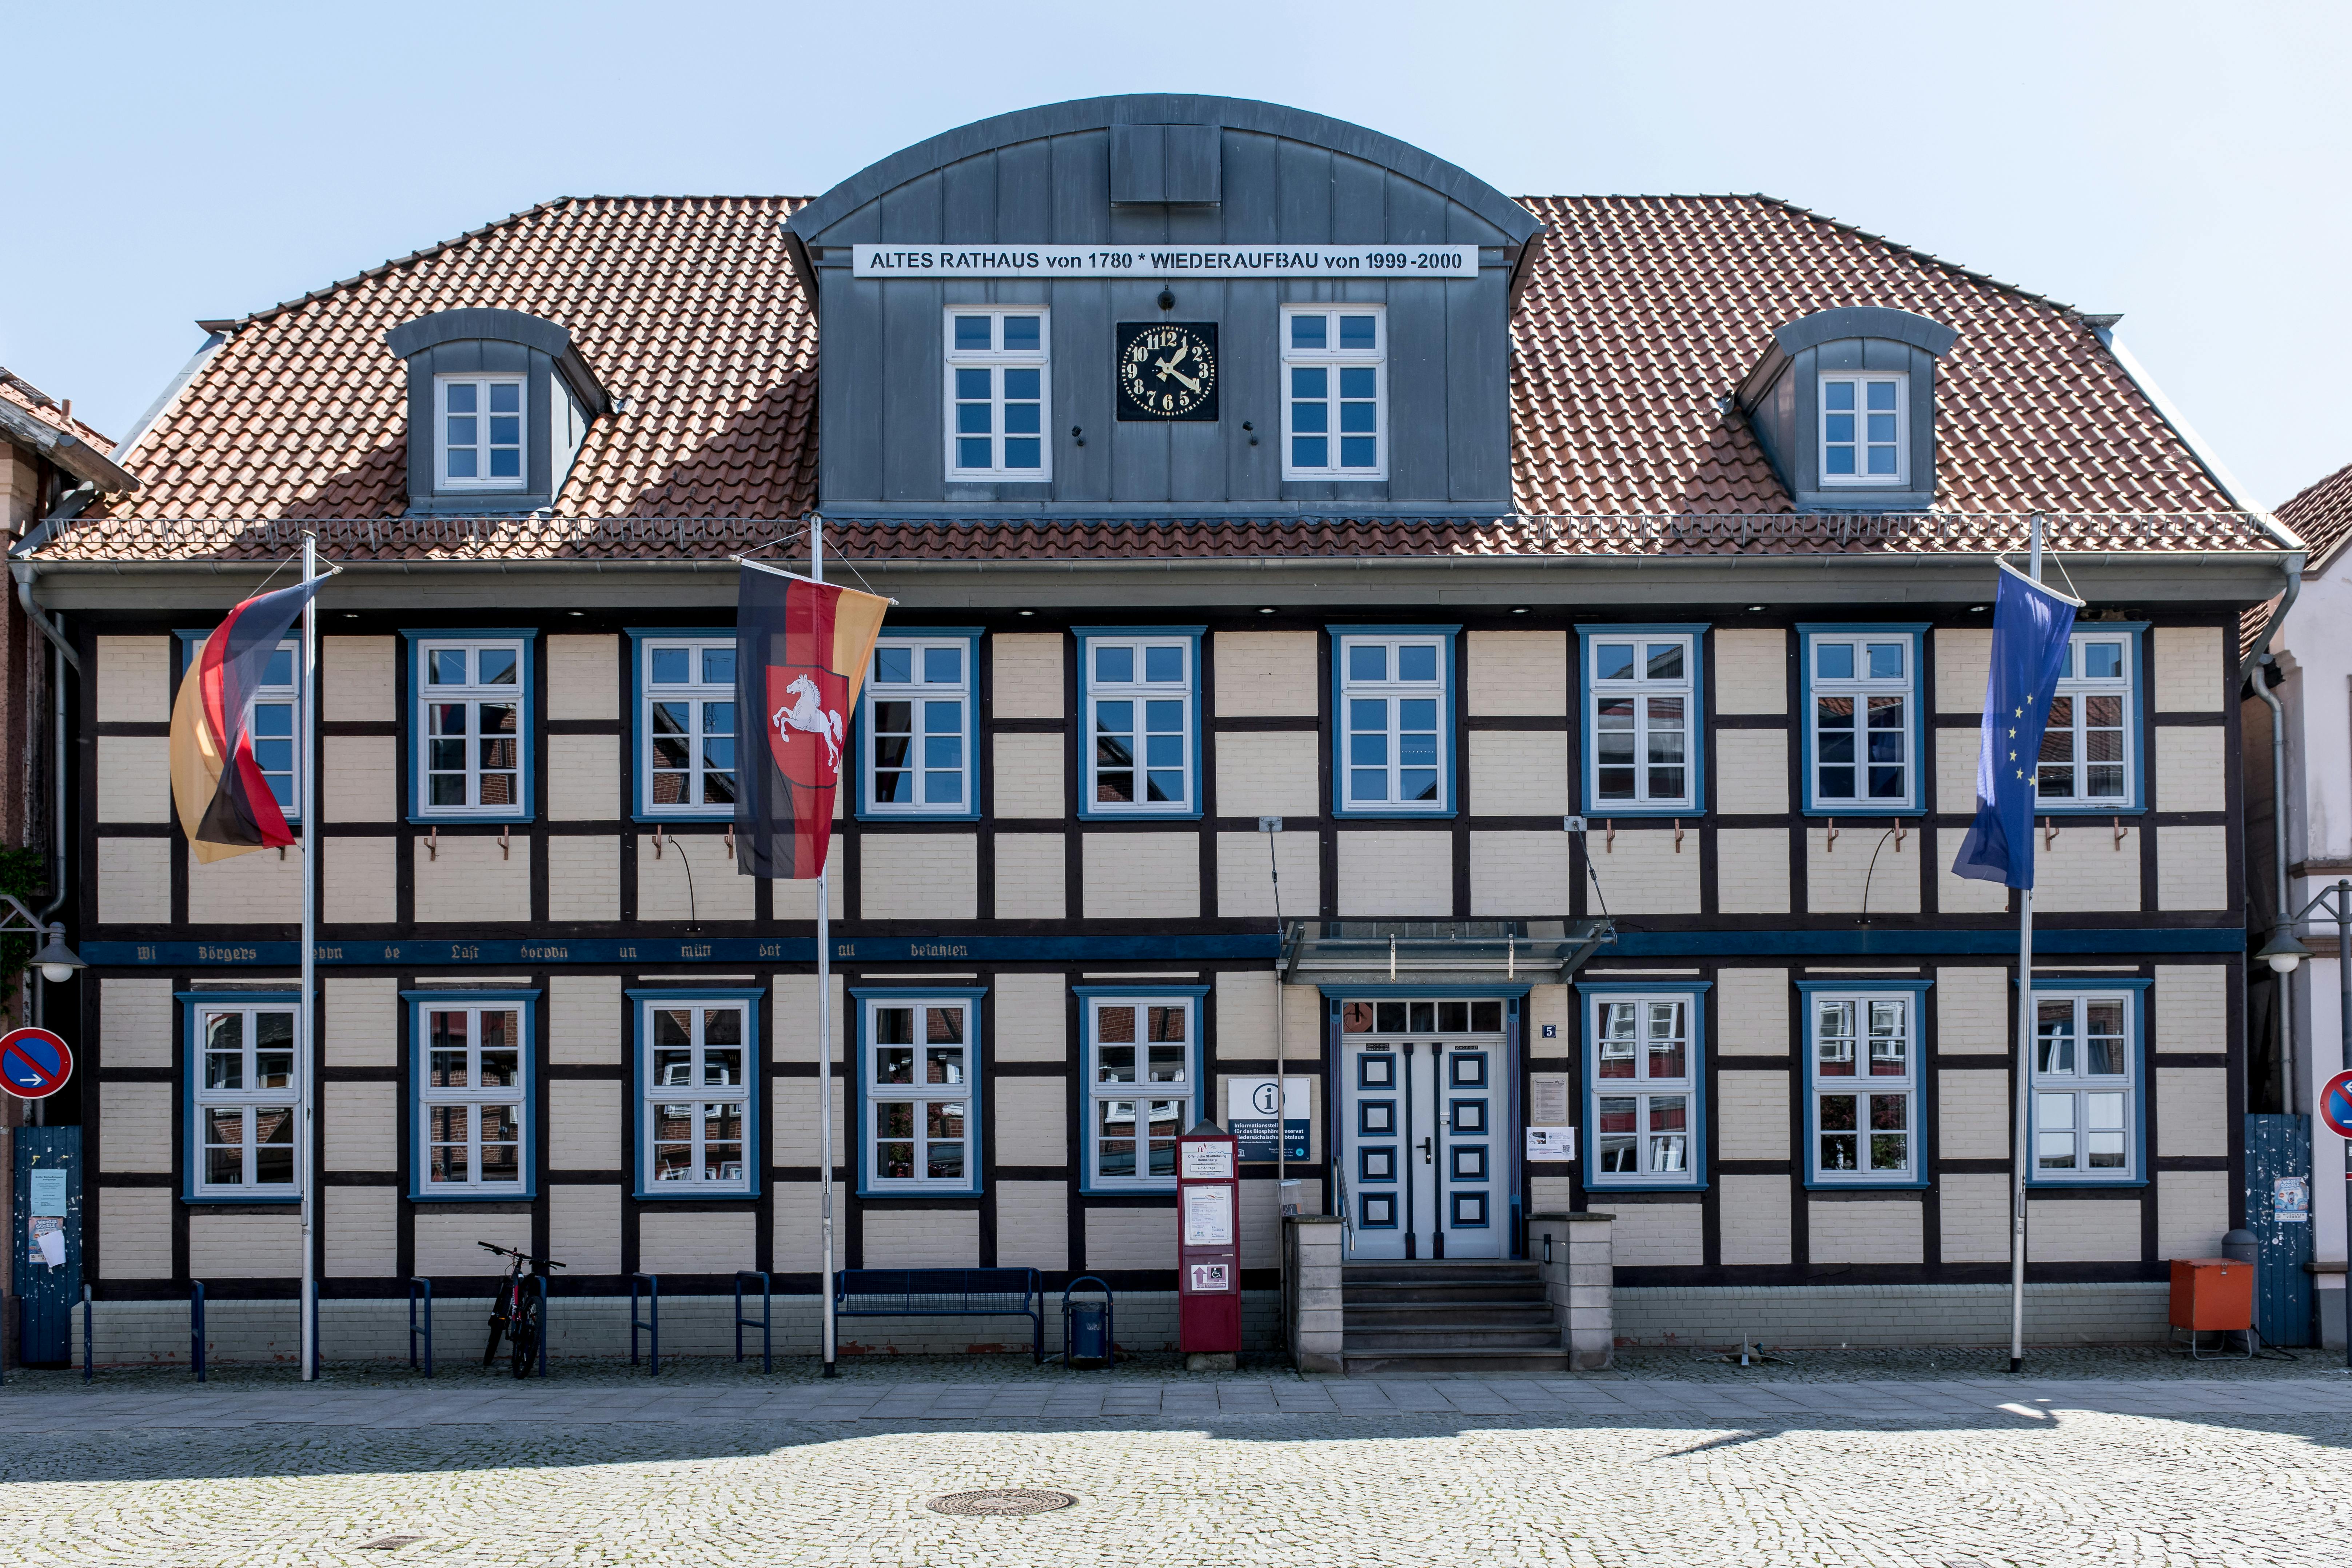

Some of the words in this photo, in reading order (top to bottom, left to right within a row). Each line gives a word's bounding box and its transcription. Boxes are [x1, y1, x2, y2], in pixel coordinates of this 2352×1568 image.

[870, 252, 933, 268] ALTES
[941, 252, 1039, 268] RATHAUS
[1046, 256, 1081, 268] von
[1088, 253, 1132, 268] 1780
[1151, 253, 1318, 268] WIEDERAUFBAU
[1324, 257, 1359, 268] von
[1366, 253, 1462, 268] 1999-2000
[1147, 335, 1160, 350] 11
[1160, 331, 1177, 347] 12
[1181, 336, 1188, 351] 1
[1132, 346, 1148, 362] 10
[1192, 346, 1203, 362] 2
[1127, 363, 1137, 379] 9
[1199, 363, 1208, 378] 3
[1133, 379, 1144, 394] 8
[1147, 390, 1156, 406] 7
[1163, 394, 1173, 410] 6
[1180, 390, 1189, 406] 5
[199, 946, 256, 961] Börgers
[313, 946, 343, 959] ebbn
[385, 945, 400, 959] de
[619, 946, 637, 958] un
[838, 944, 855, 957] all
[1547, 1026, 1552, 1036] 5
